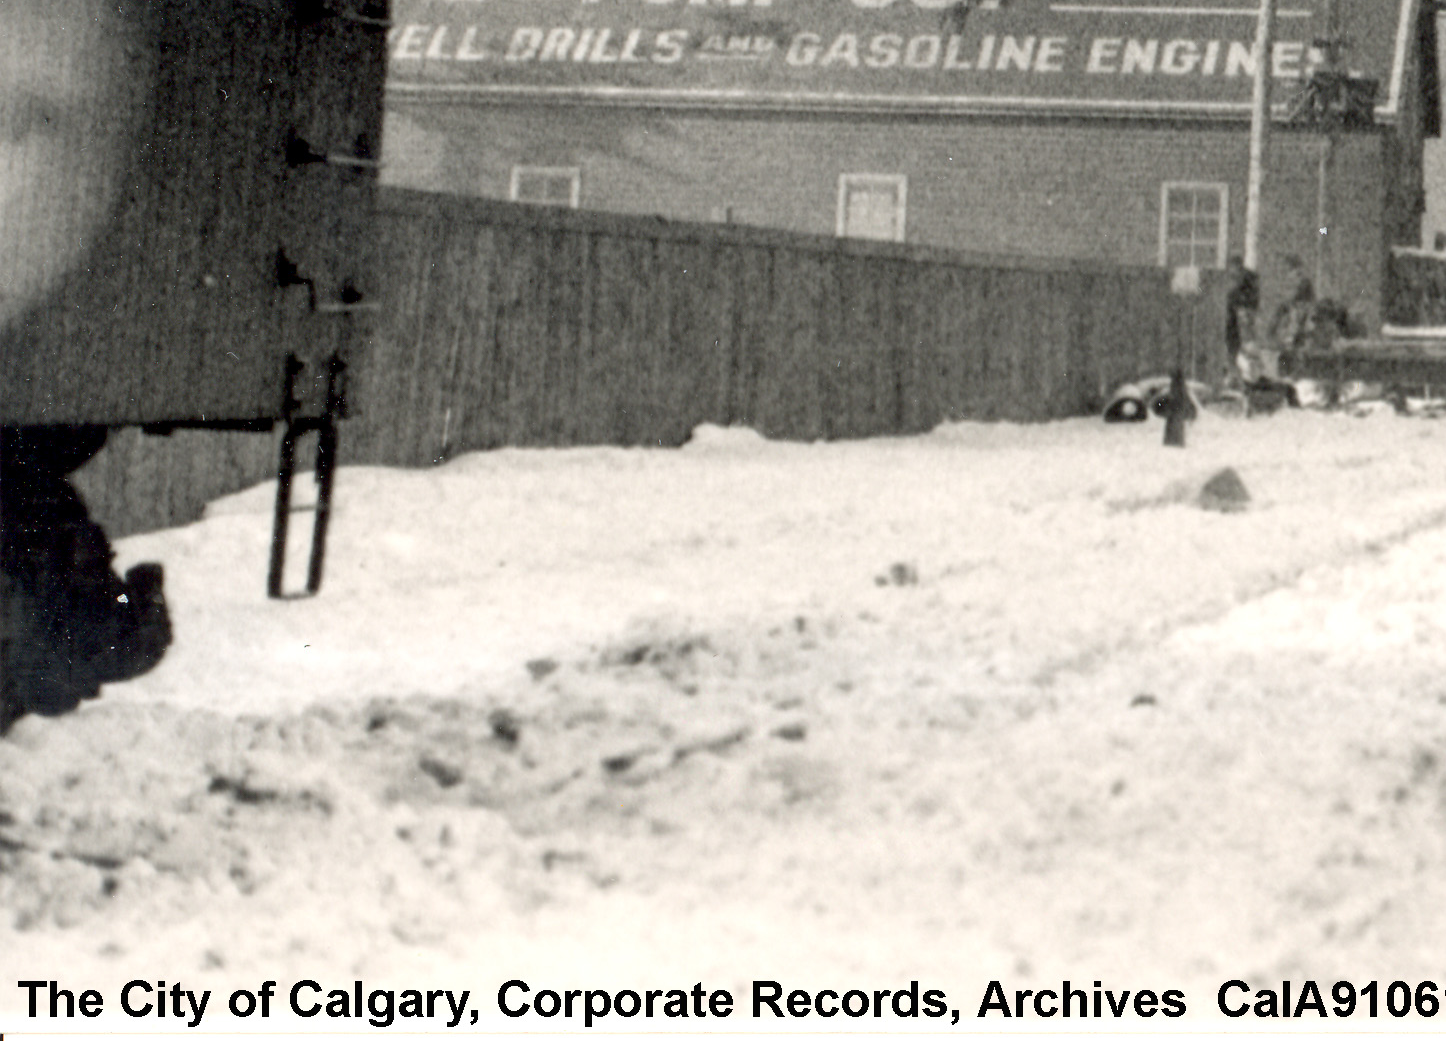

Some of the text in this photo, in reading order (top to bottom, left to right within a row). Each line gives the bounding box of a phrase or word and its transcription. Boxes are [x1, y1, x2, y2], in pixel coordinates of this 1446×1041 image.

[388, 24, 486, 62] ELL
[503, 25, 691, 64] DRILLS
[702, 34, 775, 52] AND
[786, 32, 1069, 73] GASOLINE
